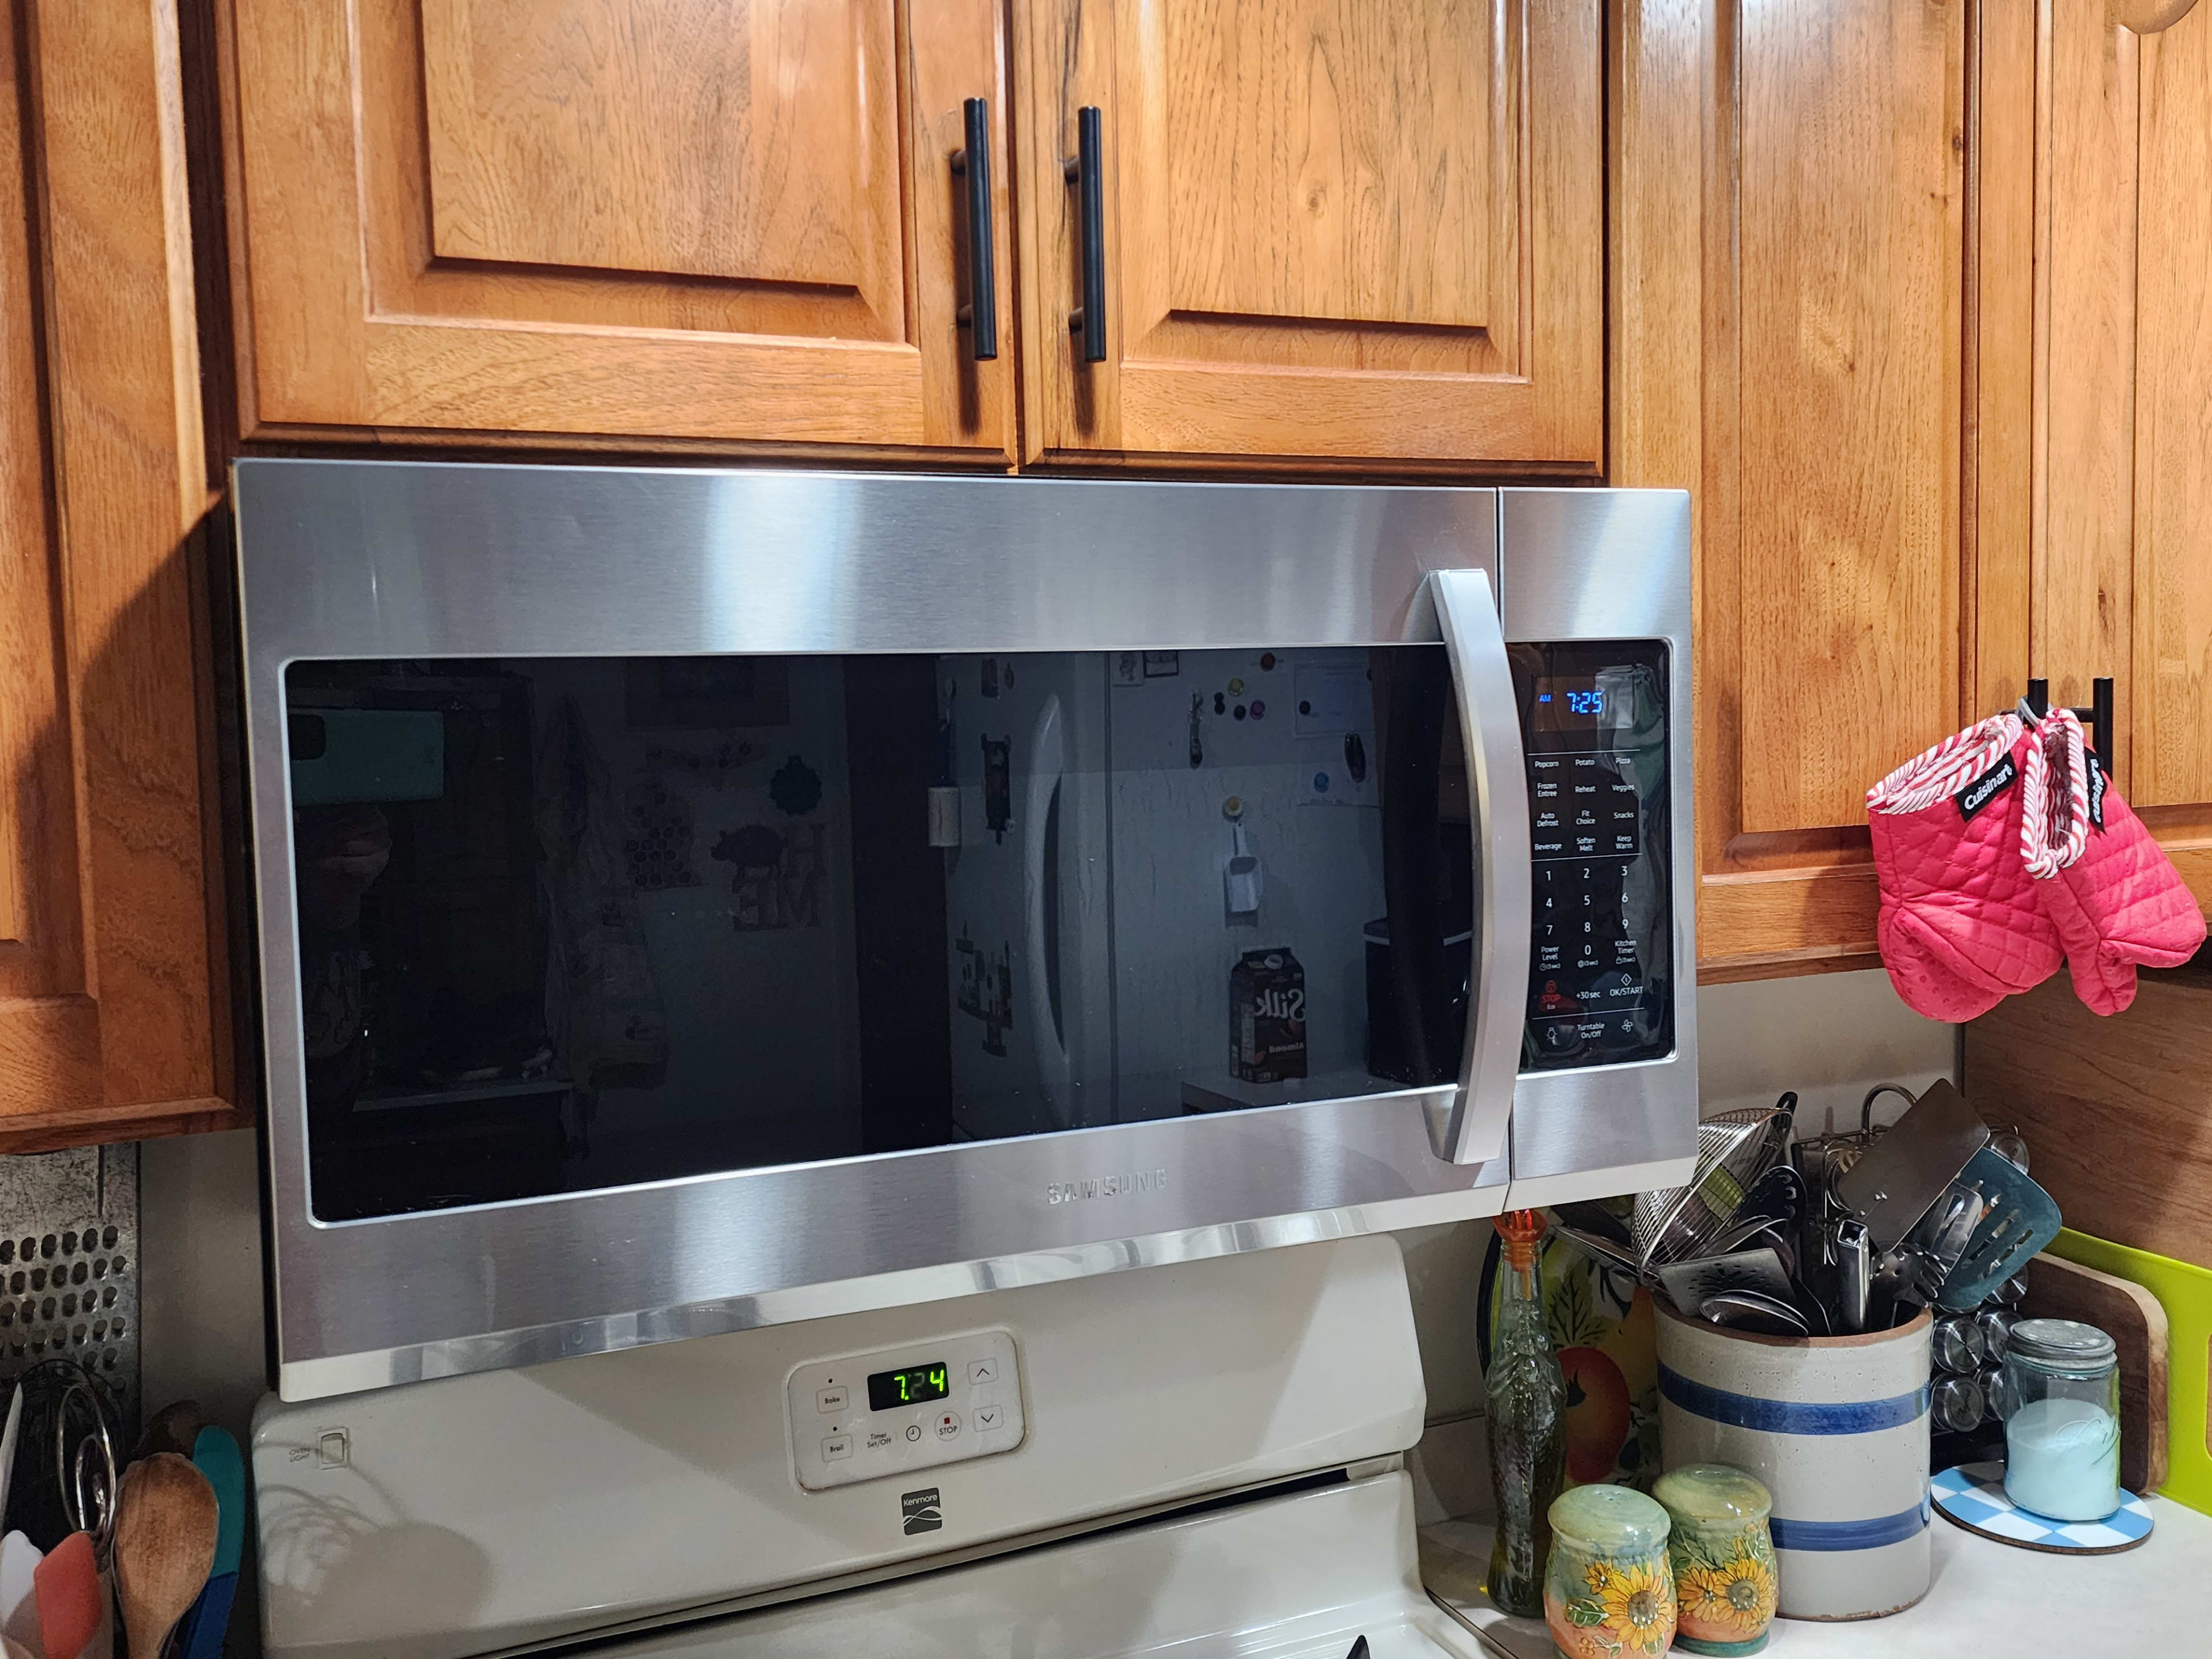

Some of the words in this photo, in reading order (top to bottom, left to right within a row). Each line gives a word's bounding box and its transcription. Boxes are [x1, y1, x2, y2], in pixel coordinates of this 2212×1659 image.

[1539, 694, 1551, 703] AM
[1567, 692, 1604, 714] 7:25
[1575, 758, 1595, 766] Potato
[1575, 785, 1596, 793] Reheat
[1612, 784, 1635, 793] Veggies
[1964, 763, 2013, 810] Cuisinart
[1613, 811, 1634, 819] Snacks
[1537, 819, 1559, 827] Defrost
[1576, 817, 1596, 825] Choice
[1577, 836, 1596, 844] Soften
[1617, 835, 1632, 843] Keep
[1535, 843, 1562, 851] Beverage
[1580, 844, 1593, 852] Melt
[1546, 870, 1551, 881] 1
[1584, 868, 1590, 878] 2
[1621, 866, 1628, 876] 3
[1584, 895, 1590, 906] 5
[1622, 893, 1628, 903] 6
[1546, 898, 1553, 908] 4
[1584, 922, 1591, 932] 8
[1622, 919, 1629, 929] 9
[1547, 925, 1554, 935] 7
[1585, 945, 1591, 955] 0
[1542, 953, 1558, 961] Level
[1609, 986, 1644, 997] OK/START
[1541, 994, 1560, 1002] STOP
[1577, 1022, 1605, 1031] Turntable
[1581, 1030, 1601, 1039] On/Off
[1047, 1168, 1168, 1205] SAMSUNG
[825, 1396, 840, 1404] Bake
[938, 1426, 958, 1435] STOP
[867, 1438, 891, 1448] Set/Off
[830, 1444, 844, 1452] Broil
[903, 1493, 937, 1507] Kenmore
